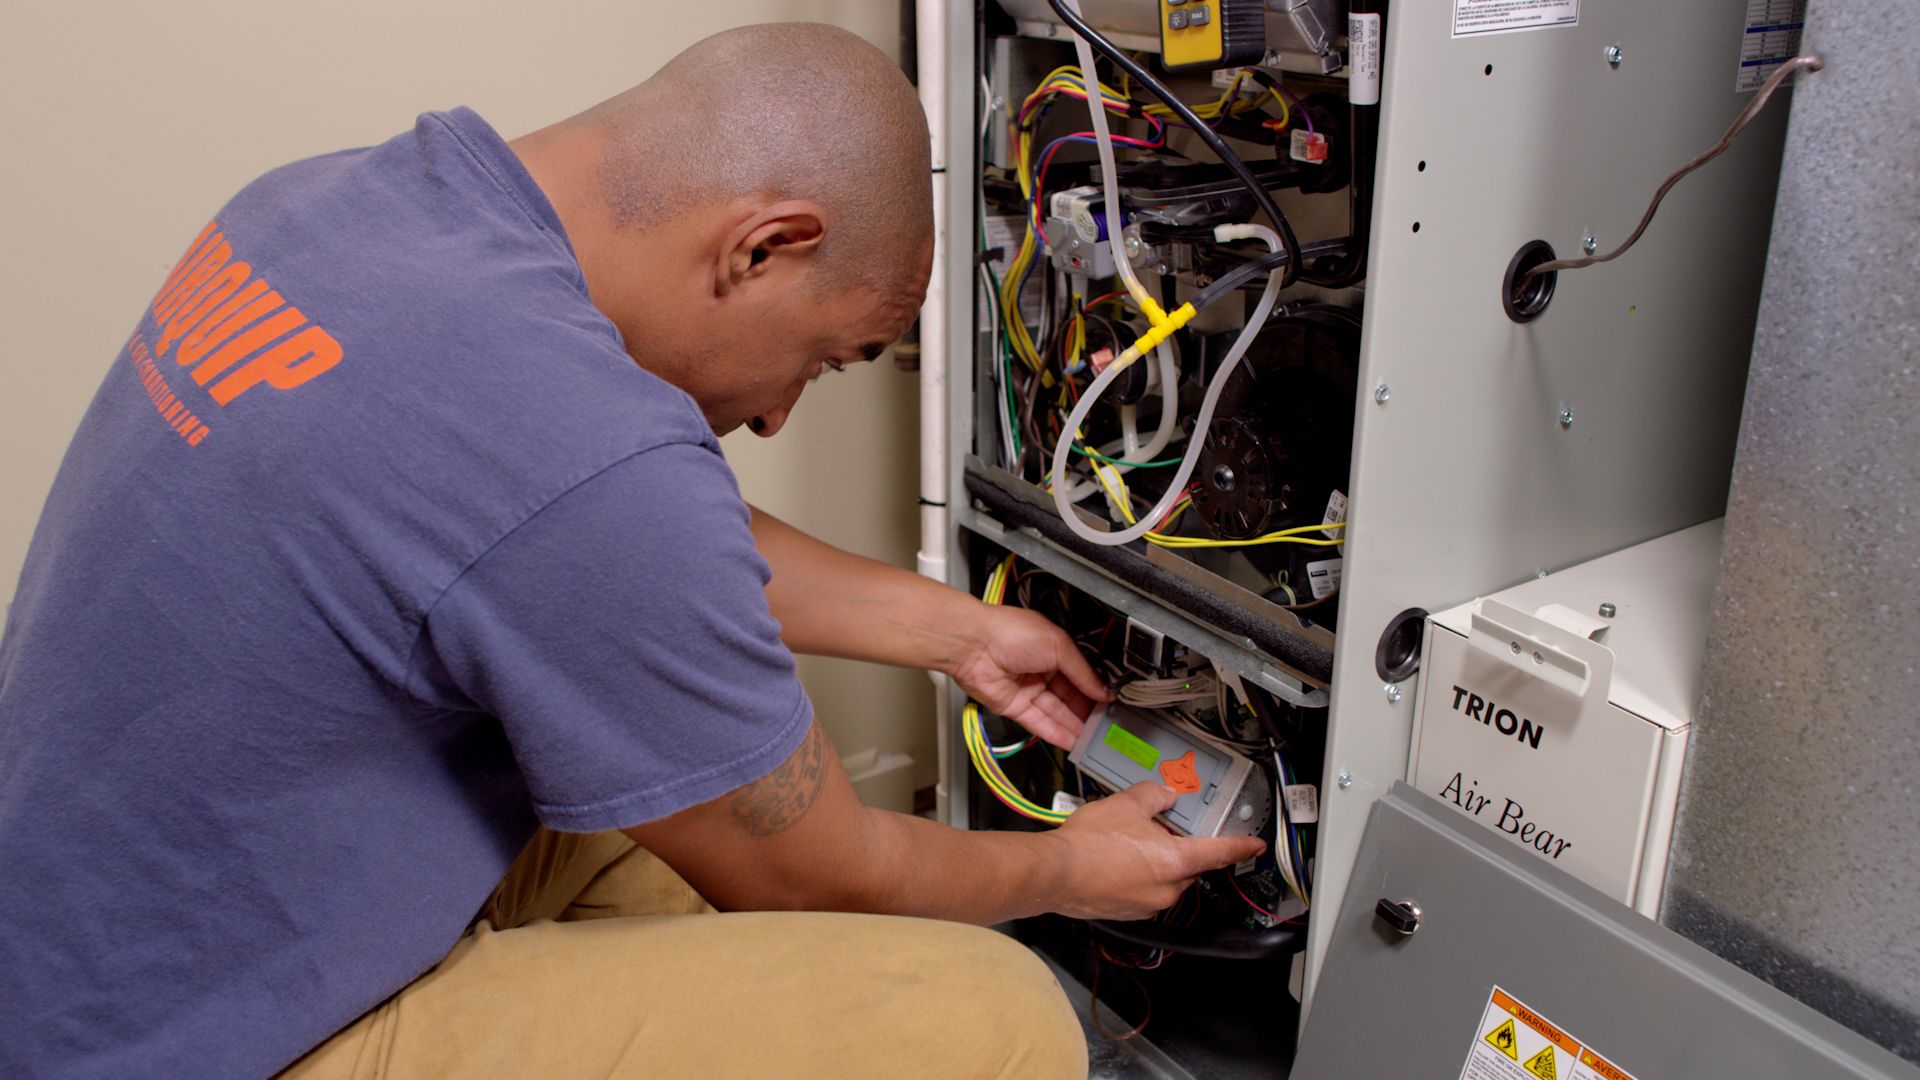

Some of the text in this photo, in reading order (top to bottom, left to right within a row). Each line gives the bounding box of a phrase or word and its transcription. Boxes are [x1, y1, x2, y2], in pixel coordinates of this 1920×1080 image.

[152, 219, 344, 407] IRQUIP
[1453, 685, 1544, 750] TRION
[1439, 772, 1571, 859] Air Bear
[1518, 1007, 1562, 1042] WARNING
[1593, 1060, 1628, 1080] AVER
